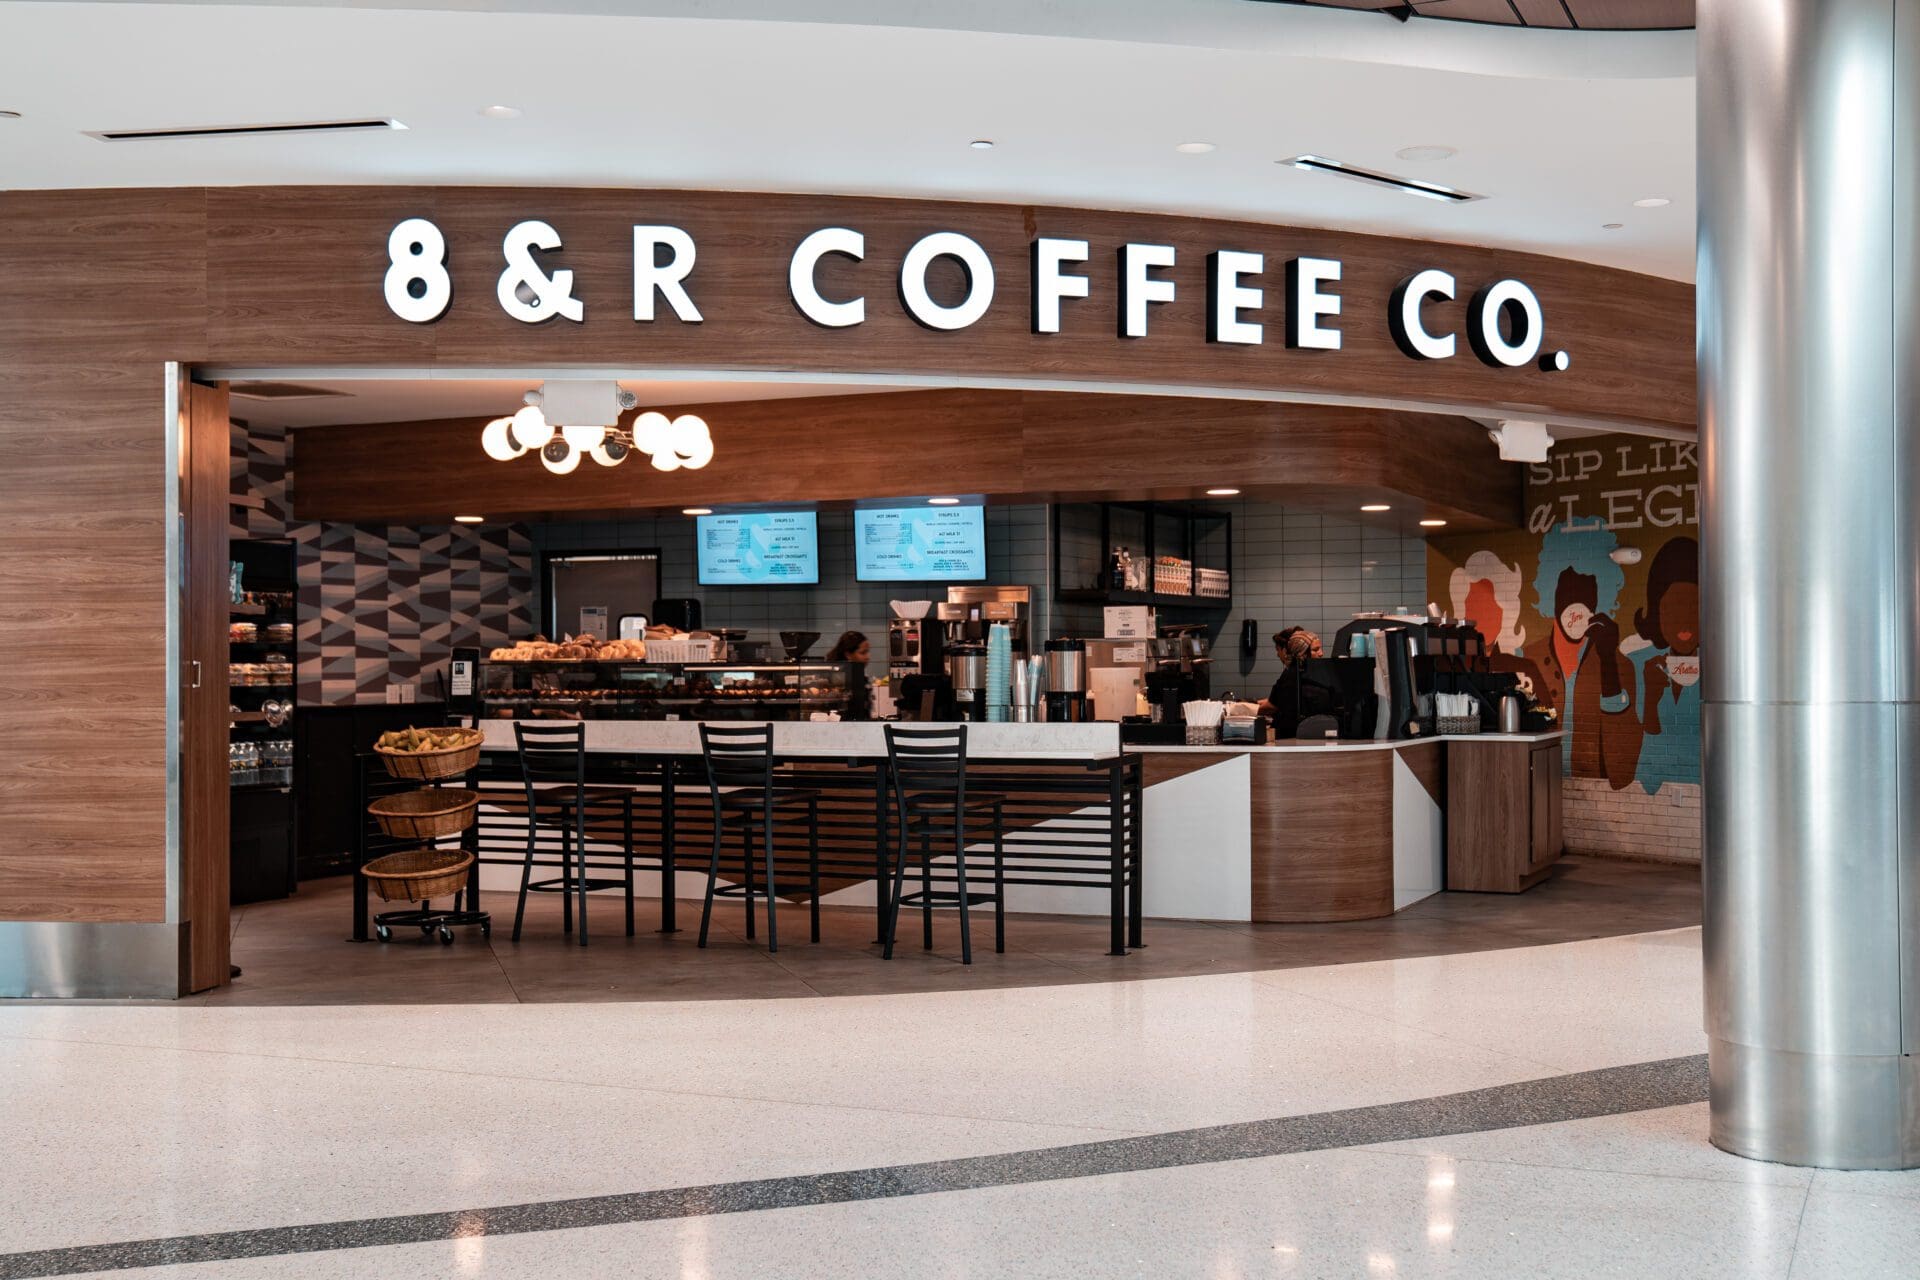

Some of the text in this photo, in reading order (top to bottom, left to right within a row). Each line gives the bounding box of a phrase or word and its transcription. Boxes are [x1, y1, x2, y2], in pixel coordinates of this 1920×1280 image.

[384, 218, 1570, 371] 8 & R COFFEE CO.
[1529, 449, 1603, 485] SIP
